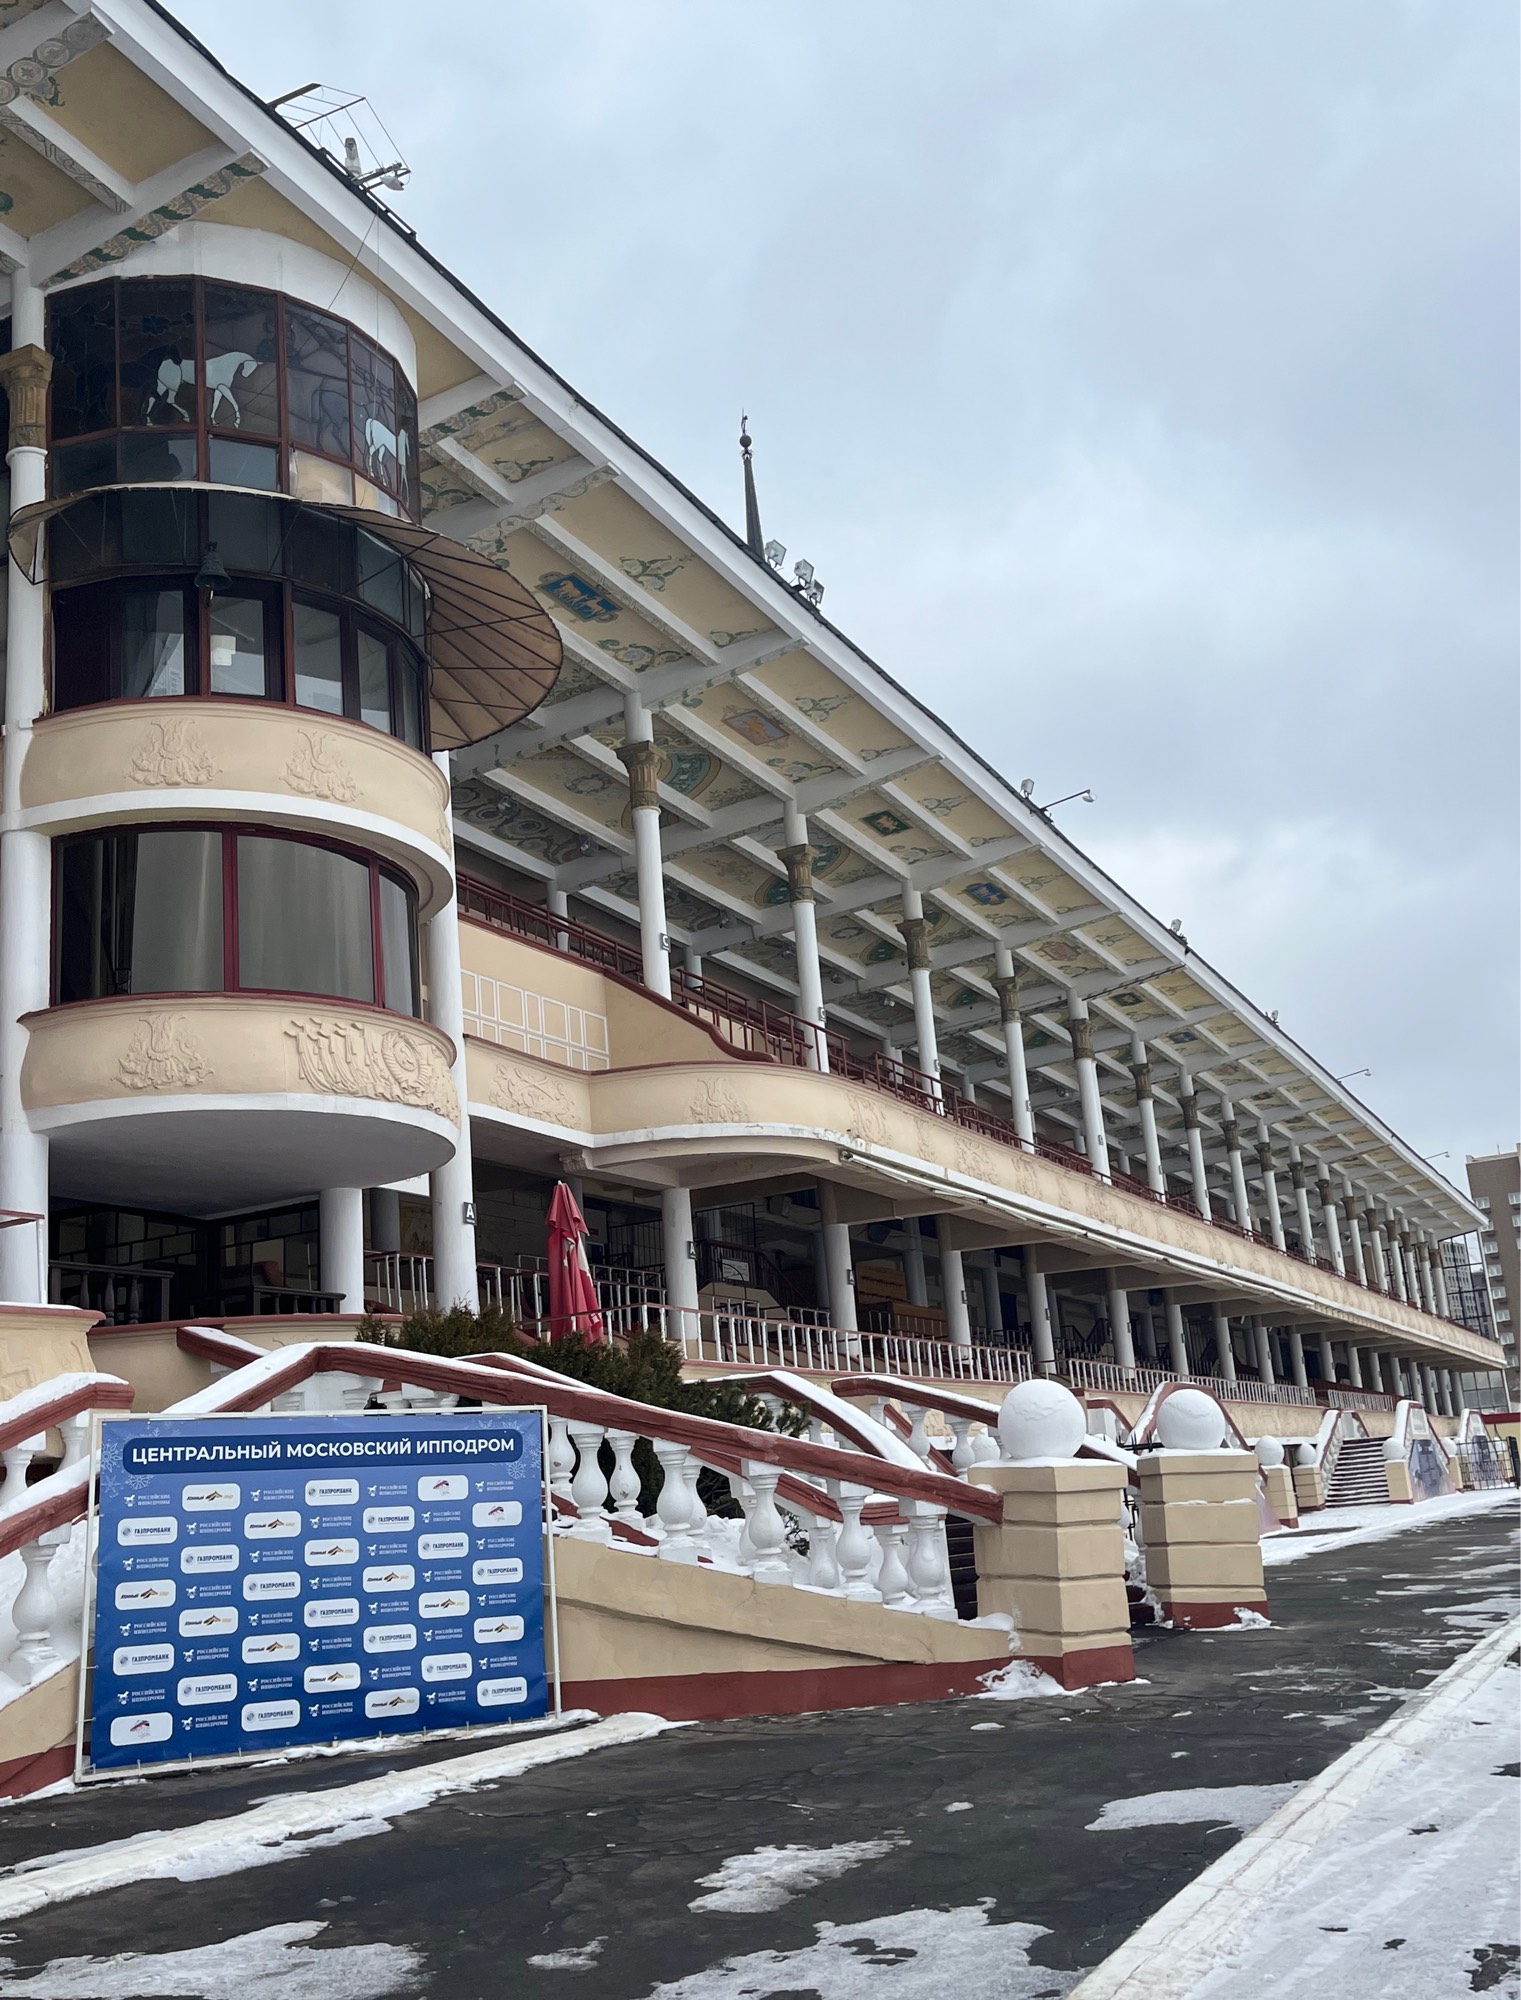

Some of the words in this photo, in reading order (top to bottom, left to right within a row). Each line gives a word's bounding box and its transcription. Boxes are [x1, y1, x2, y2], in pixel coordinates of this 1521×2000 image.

[466, 1204, 474, 1218] A
[132, 1441, 280, 1464] ЦЕНТРАЛЬНЫЙ
[286, 1438, 411, 1458] МОСКОВСКИЙ
[416, 1438, 514, 1454] ИППОДРОМ
[134, 1526, 170, 1534] ГАЗПРОМБАНК
[260, 1581, 295, 1589] ГАЗПРОМБАНК
[320, 1607, 353, 1615] ГАЗПРОМБАНК
[131, 1653, 169, 1662] ГАЗПРОМБАНК
[195, 1683, 231, 1692] ГАЗПРОМБАНК
[258, 1709, 293, 1719] ГАЗПРОМБАНК
